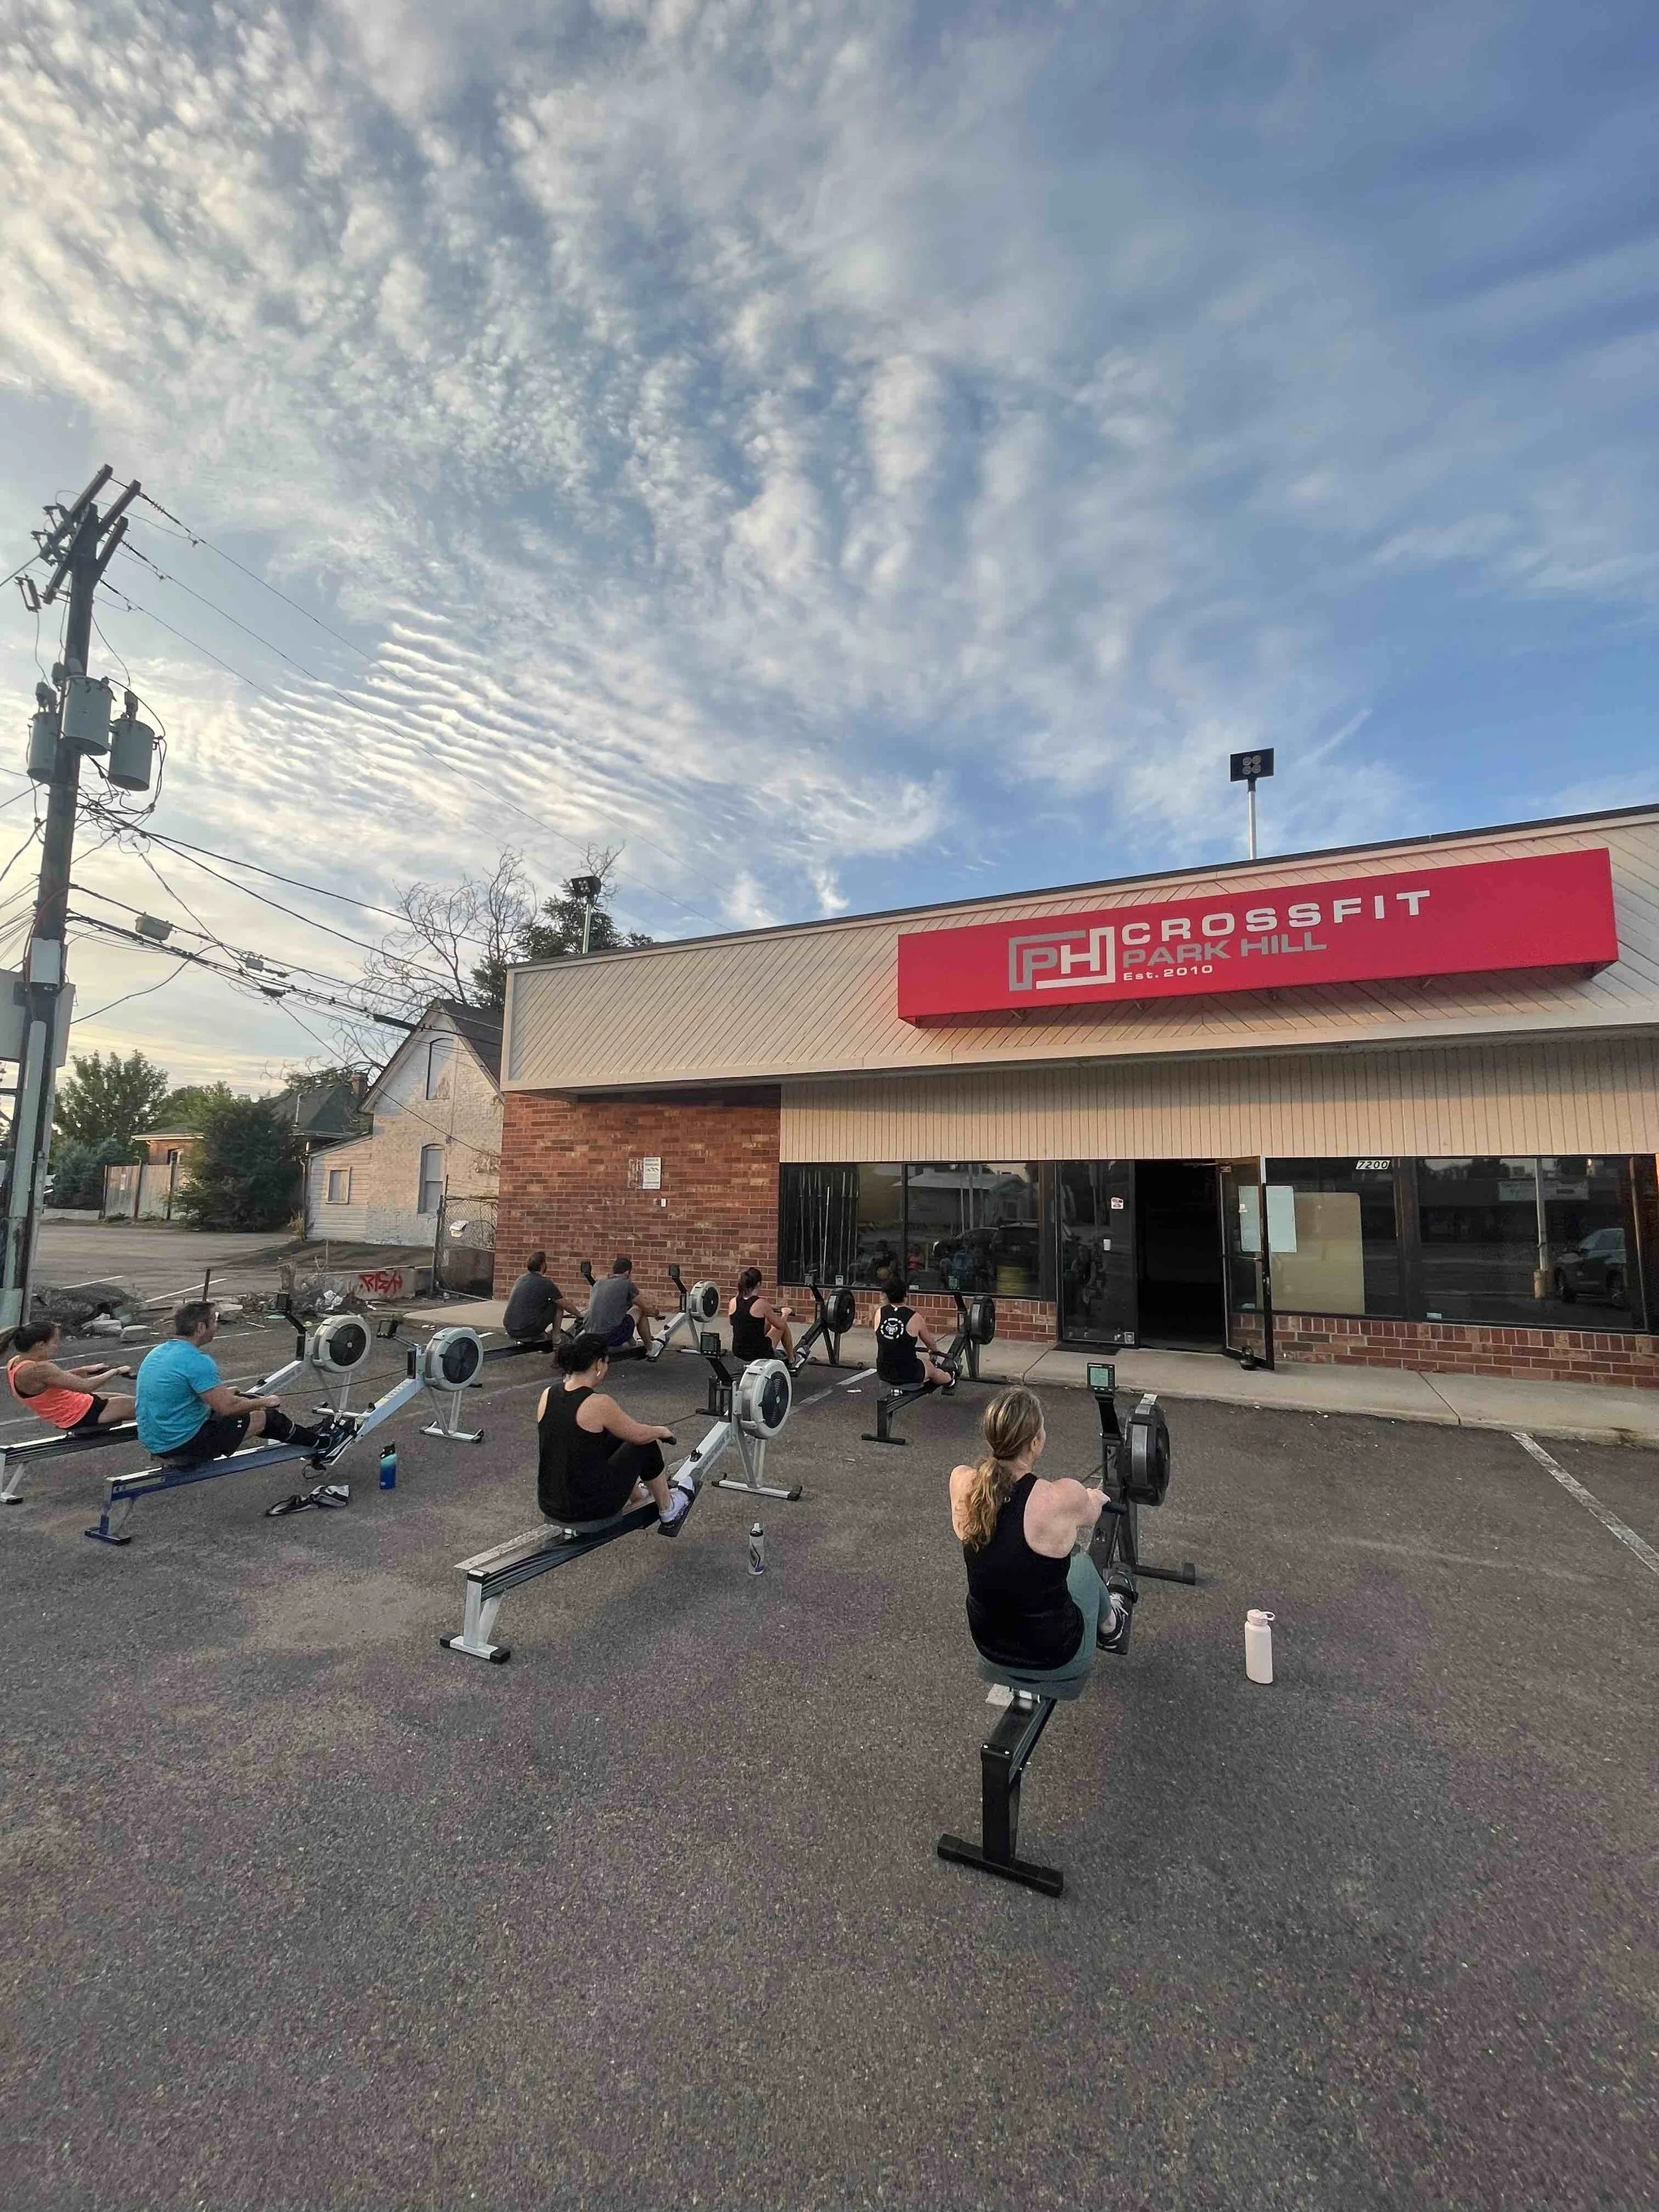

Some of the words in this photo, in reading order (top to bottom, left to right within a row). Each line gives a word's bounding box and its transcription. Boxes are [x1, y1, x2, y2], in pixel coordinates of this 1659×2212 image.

[1121, 890, 1430, 945] CROSSFIT
[1123, 940, 1232, 968] PARK
[1240, 931, 1327, 957] HILL
[1123, 971, 1159, 982] Est.
[1163, 965, 1213, 978] 2010
